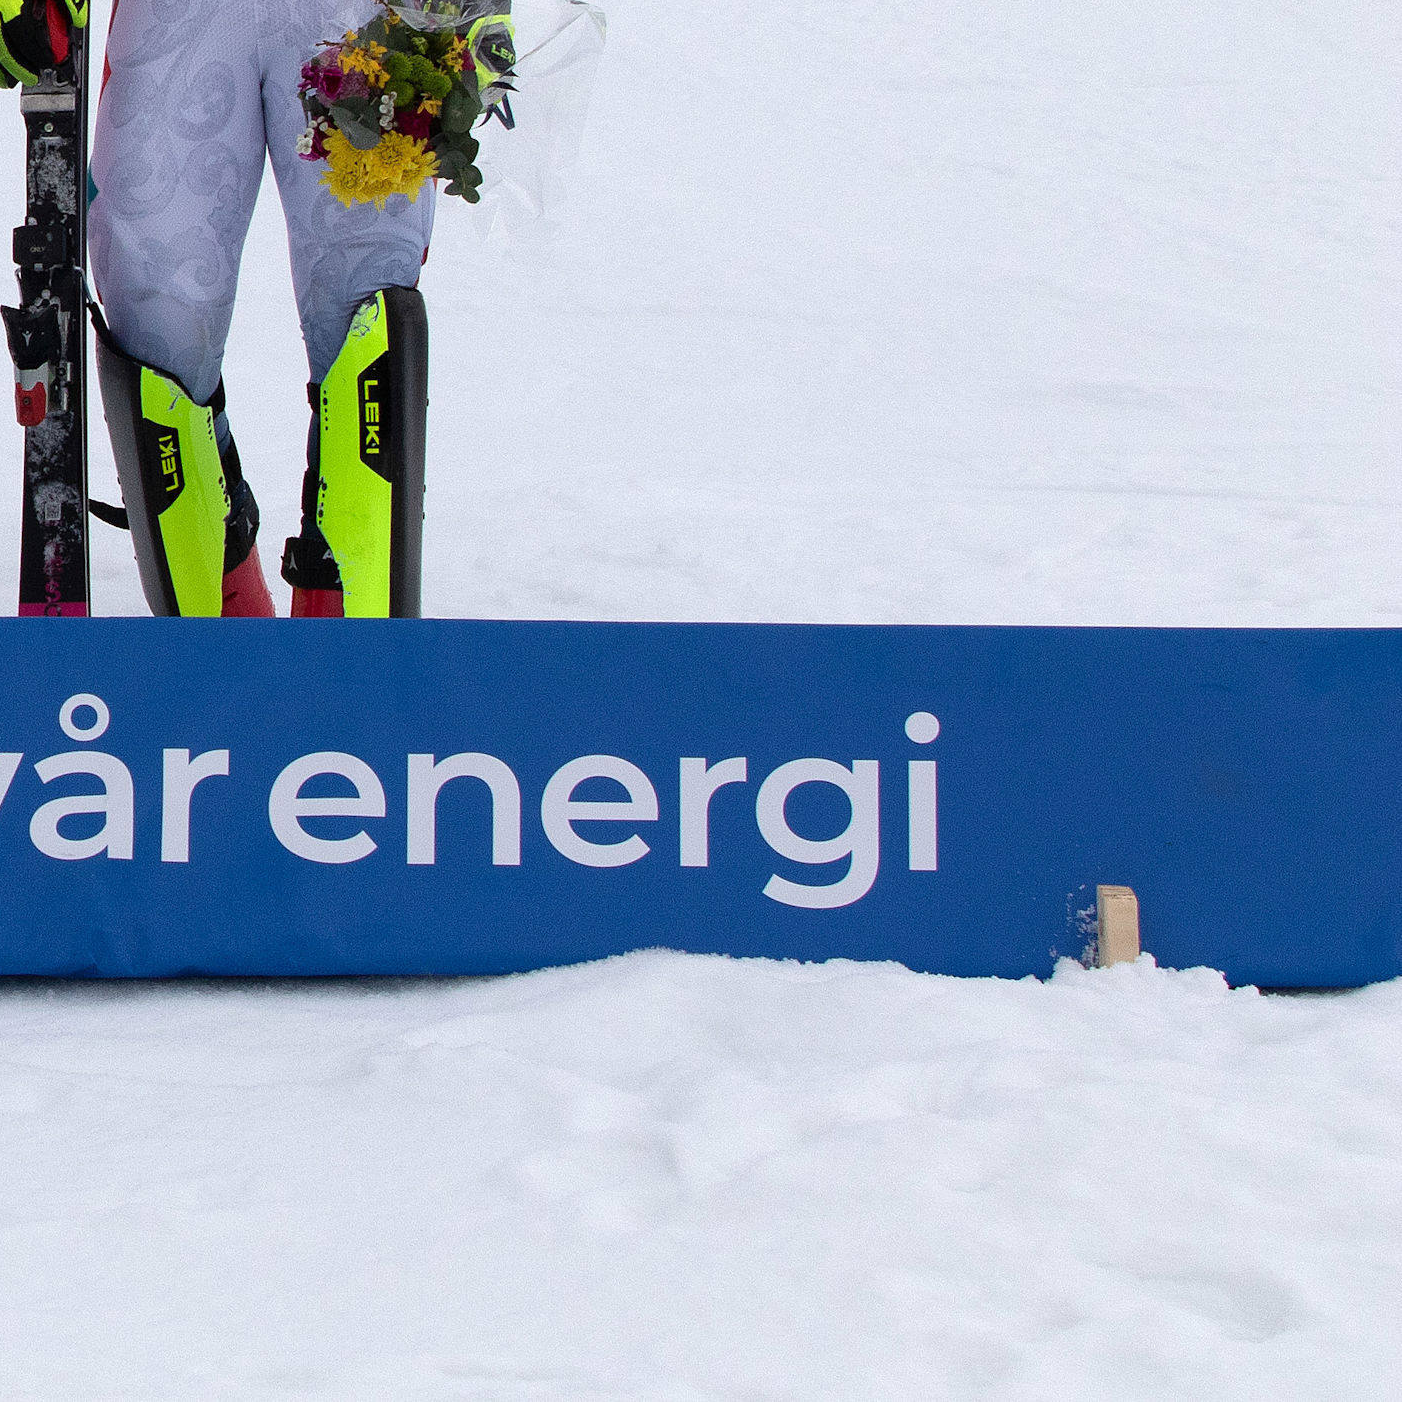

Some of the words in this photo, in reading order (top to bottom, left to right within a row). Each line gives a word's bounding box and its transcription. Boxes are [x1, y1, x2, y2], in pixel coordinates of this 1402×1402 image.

[364, 379, 380, 455] LEKI
[158, 435, 179, 492] LEKI
[267, 711, 941, 910] energi
